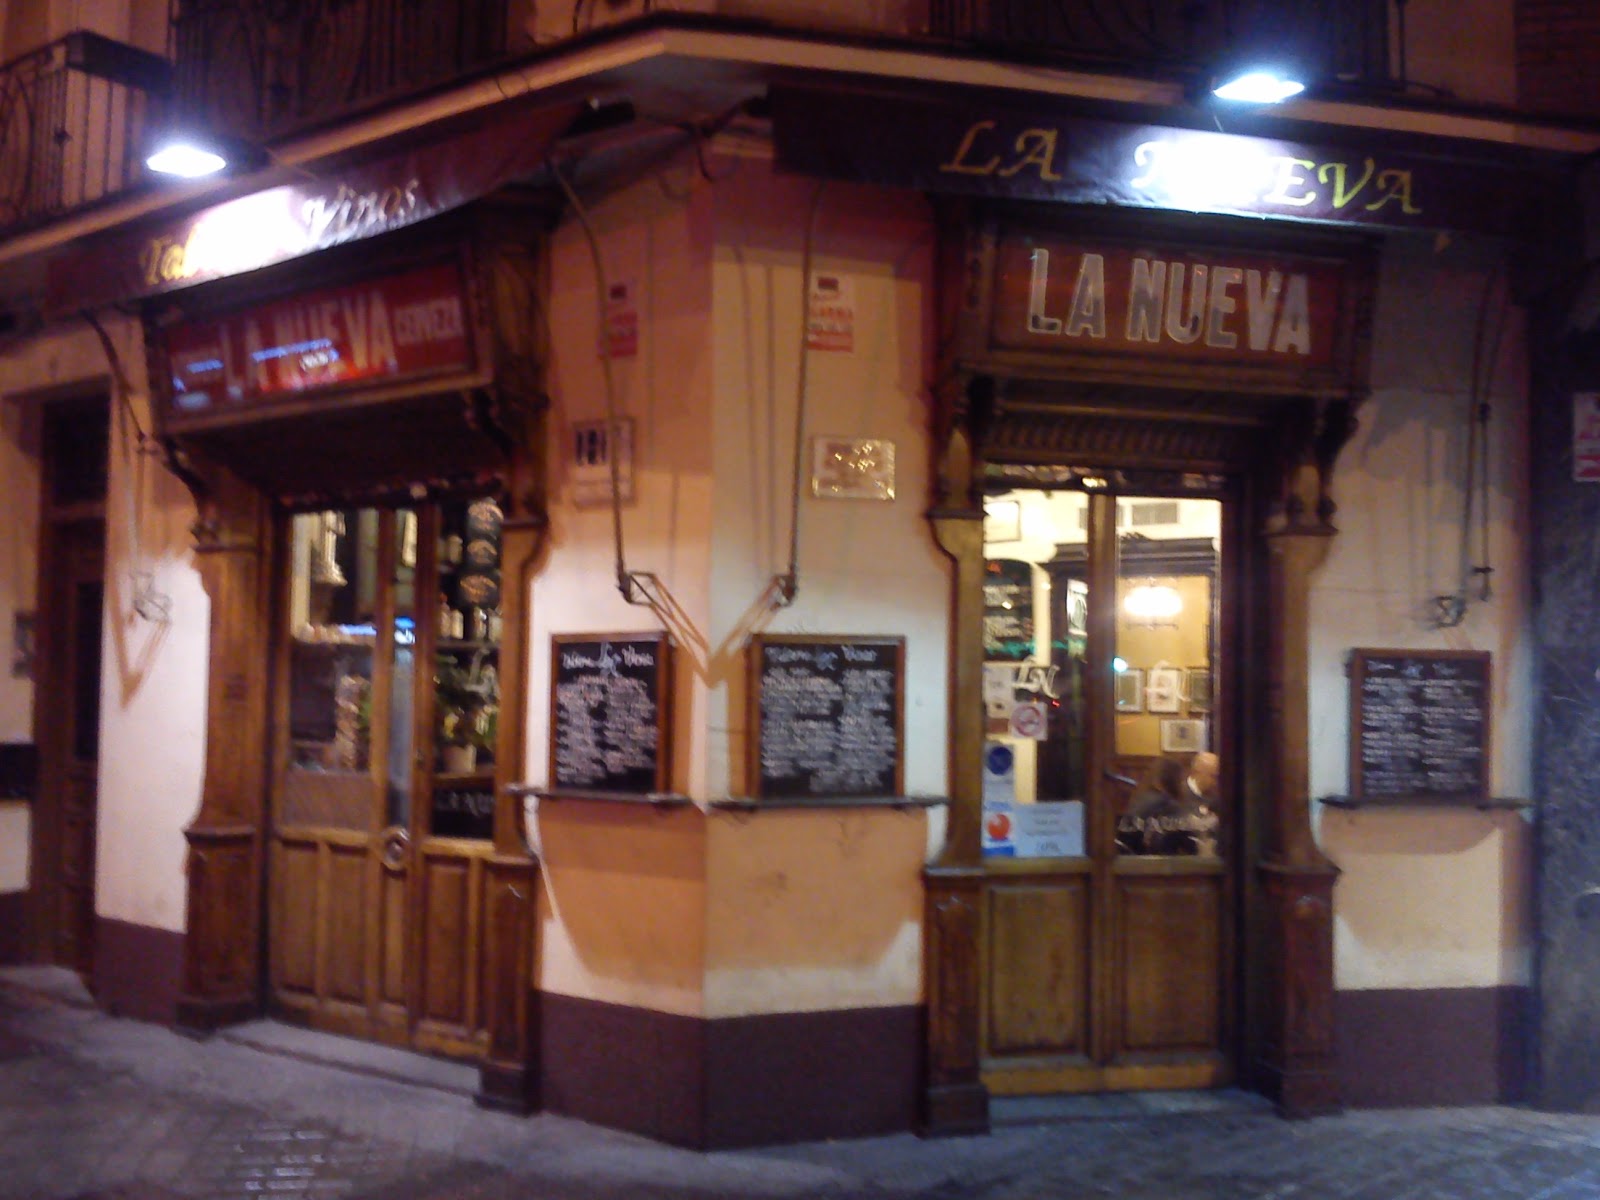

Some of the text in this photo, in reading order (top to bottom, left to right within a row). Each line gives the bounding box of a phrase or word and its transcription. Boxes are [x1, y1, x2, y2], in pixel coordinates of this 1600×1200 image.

[940, 120, 1062, 181] LA
[1026, 247, 1312, 355] LA NUEVA
